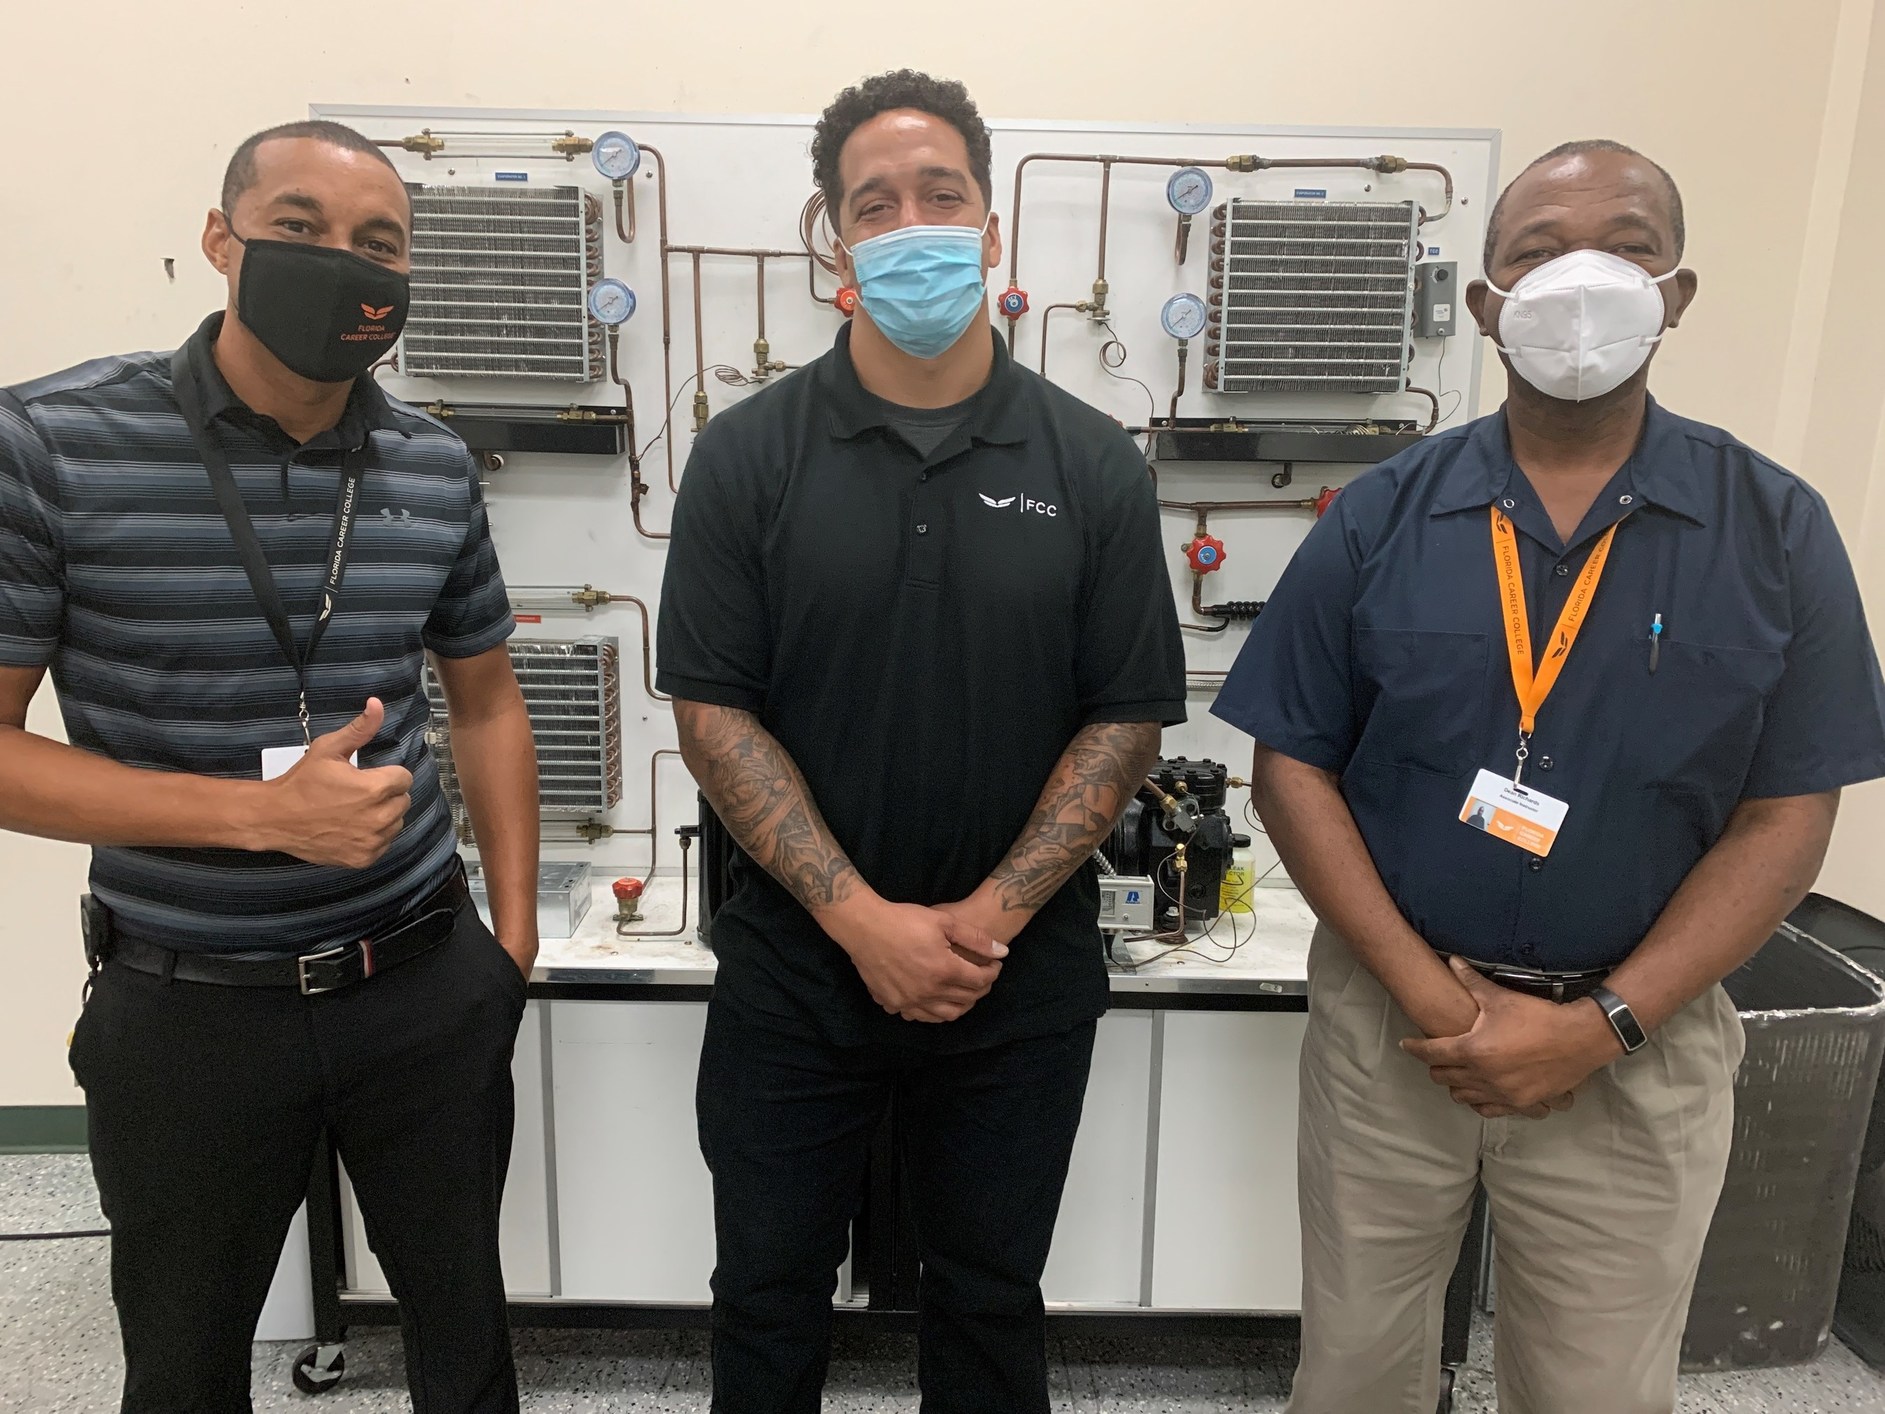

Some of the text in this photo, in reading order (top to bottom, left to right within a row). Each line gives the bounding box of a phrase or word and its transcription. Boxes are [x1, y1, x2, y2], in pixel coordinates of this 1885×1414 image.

[329, 476, 356, 585] FLORIDA CAREER COLLEGE
[1026, 499, 1057, 517] FCC
[1502, 545, 1525, 655] FLORIDA CAREER COLLEGE
[1567, 588, 1588, 622] FLORIDA
[1584, 555, 1600, 586] CAREER
